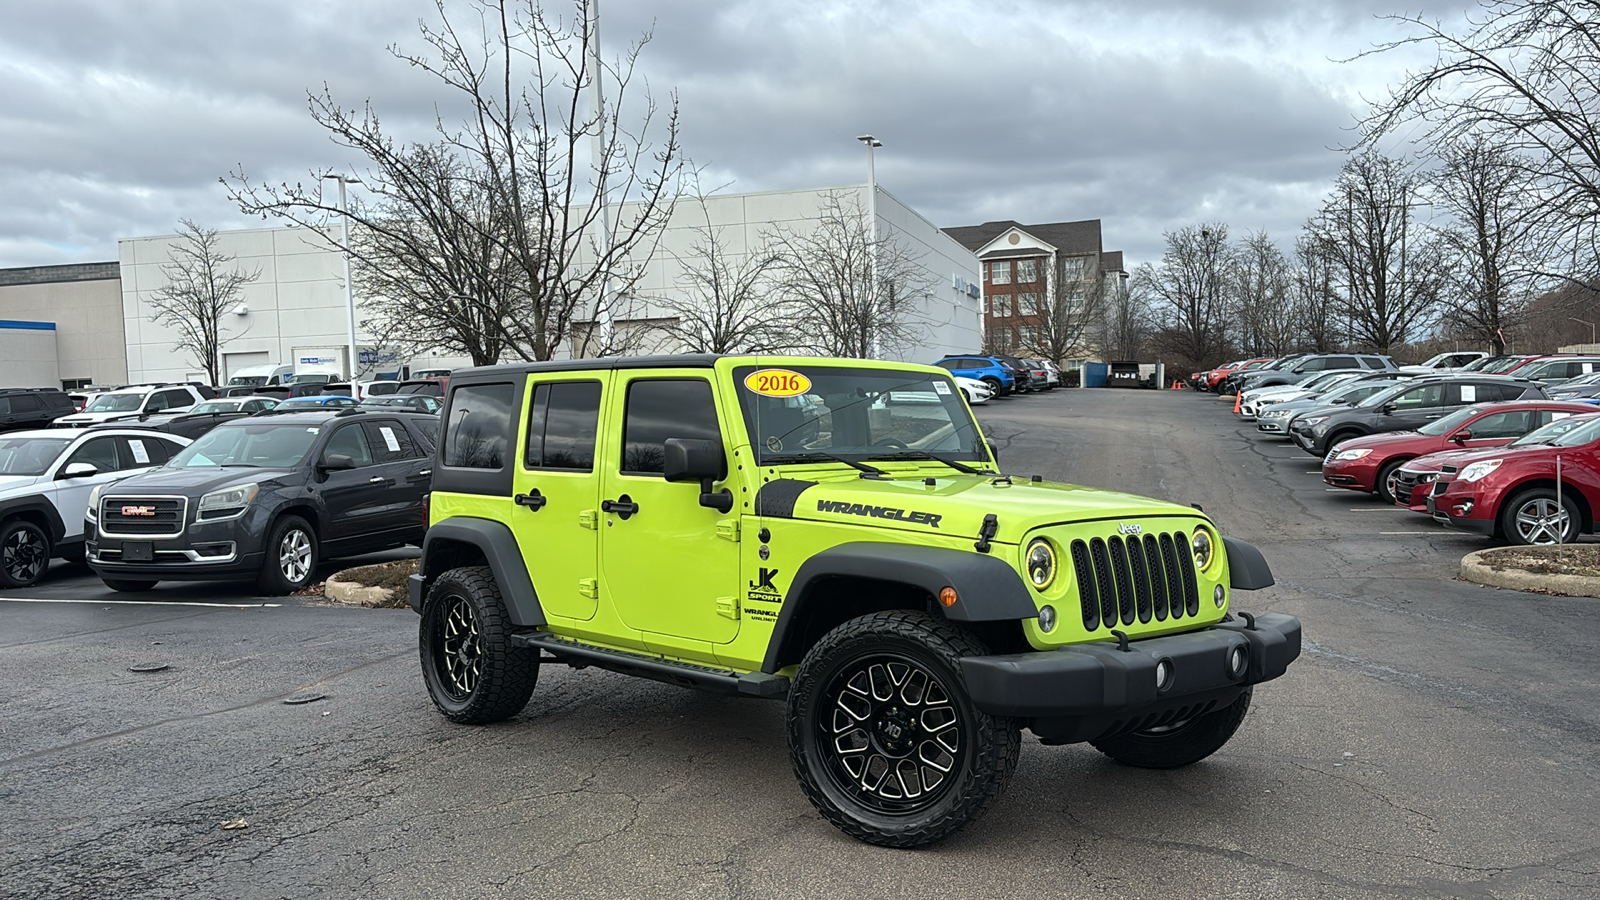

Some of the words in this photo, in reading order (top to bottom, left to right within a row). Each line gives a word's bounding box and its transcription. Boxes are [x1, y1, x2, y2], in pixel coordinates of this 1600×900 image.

[758, 375, 799, 391] 2016
[121, 506, 155, 516] GMC
[817, 499, 942, 528] WRANGLER
[1117, 522, 1142, 536] Jeep
[749, 567, 779, 593] JK
[749, 593, 780, 602] SPORT
